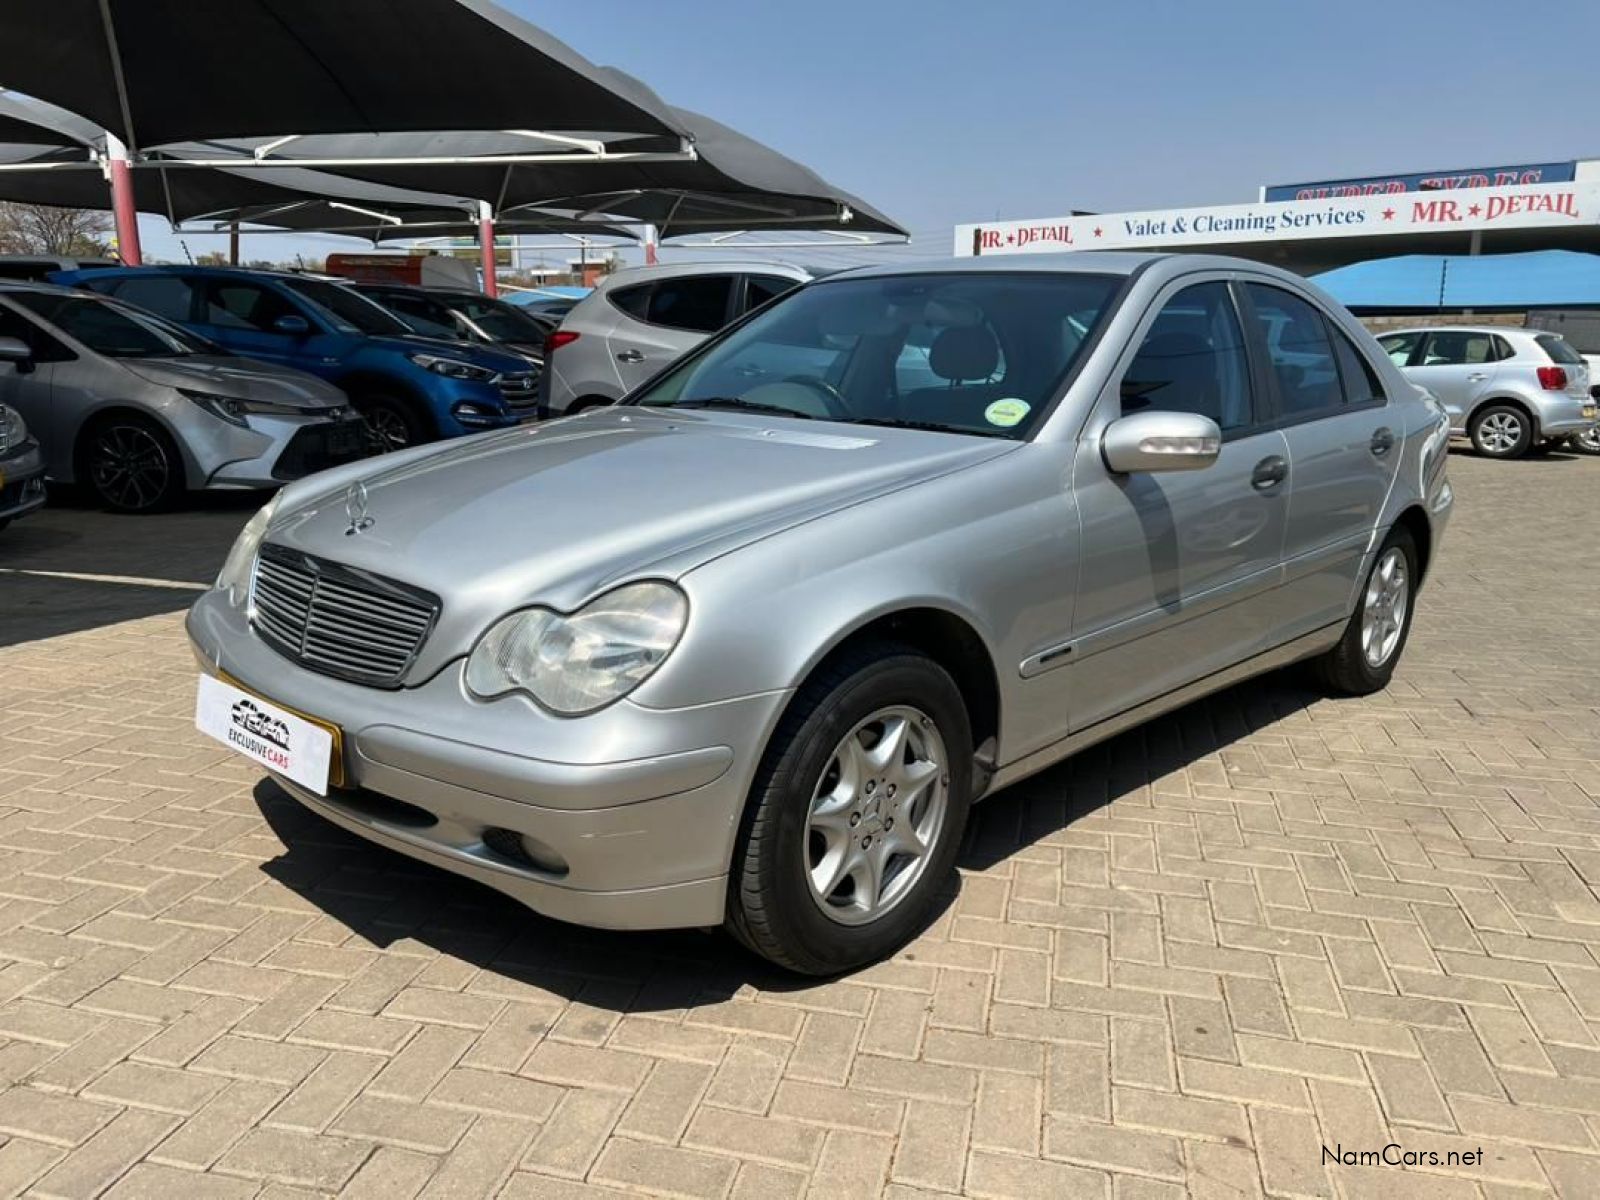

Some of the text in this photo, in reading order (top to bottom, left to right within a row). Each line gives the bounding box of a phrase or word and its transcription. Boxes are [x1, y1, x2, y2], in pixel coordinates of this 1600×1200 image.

[1124, 207, 1366, 236] Valet & Cleaning Services
[1411, 193, 1579, 223] MR. DETAIL
[1017, 225, 1073, 247] DETAIL
